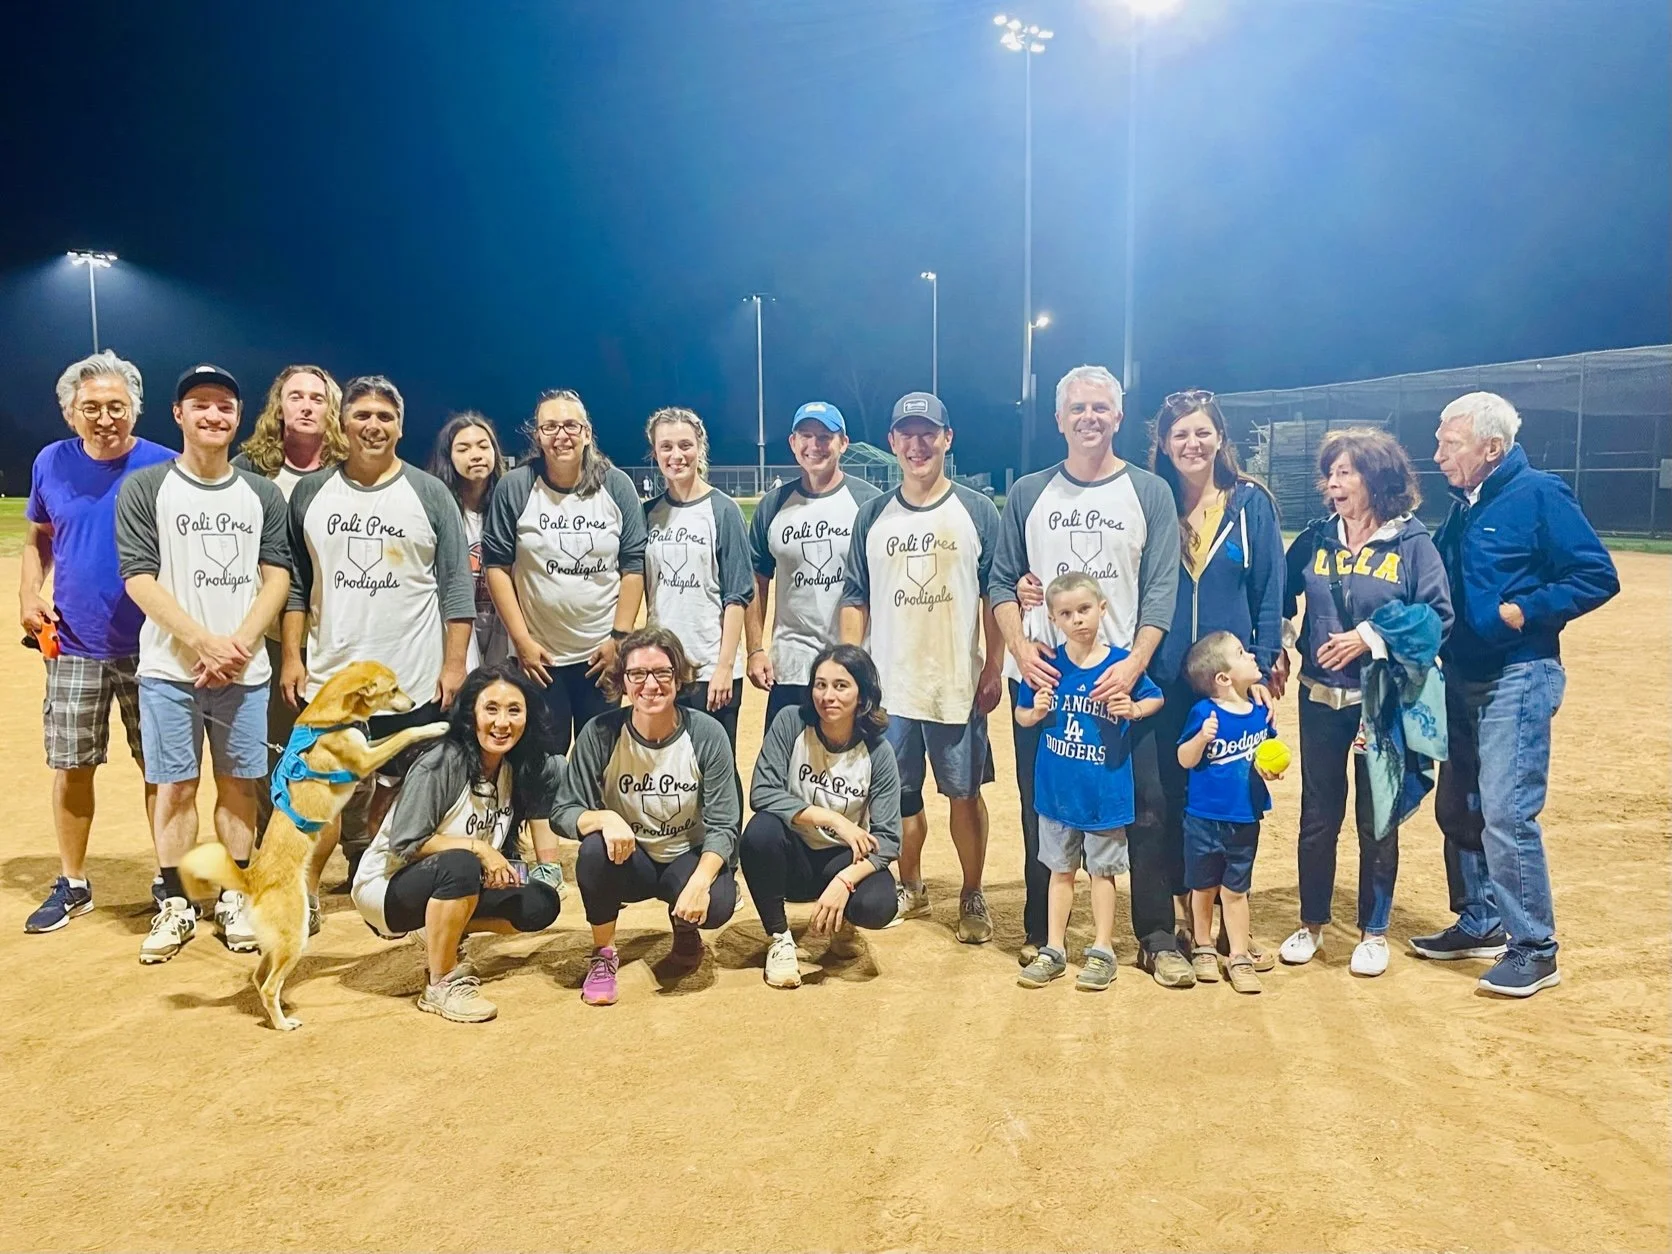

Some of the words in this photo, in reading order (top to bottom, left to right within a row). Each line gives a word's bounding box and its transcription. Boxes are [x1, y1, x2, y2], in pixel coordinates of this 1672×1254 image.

[176, 512, 212, 536] Pali
[216, 513, 253, 534] Pres
[327, 513, 362, 535] Pali
[366, 516, 406, 538] Pres
[539, 513, 569, 530] Pali
[573, 515, 607, 531] Pres
[782, 521, 812, 545] Pali
[815, 520, 851, 539] Pres
[1049, 509, 1082, 531] Pali
[1086, 510, 1125, 530] Pres
[649, 527, 673, 544] Pali
[676, 527, 706, 545] Pres
[886, 533, 918, 557] Pali
[922, 532, 957, 553] Pres
[193, 568, 252, 593] Prodigas
[546, 558, 608, 580] Prodigals
[794, 566, 844, 592] Prodigal
[334, 570, 400, 597] Prodigals
[894, 585, 953, 612] Prodigals
[1064, 712, 1084, 742] LA
[1045, 733, 1107, 762] DODGERS
[619, 773, 655, 794] Pali
[660, 774, 698, 794] Pres
[798, 763, 829, 787] Pali
